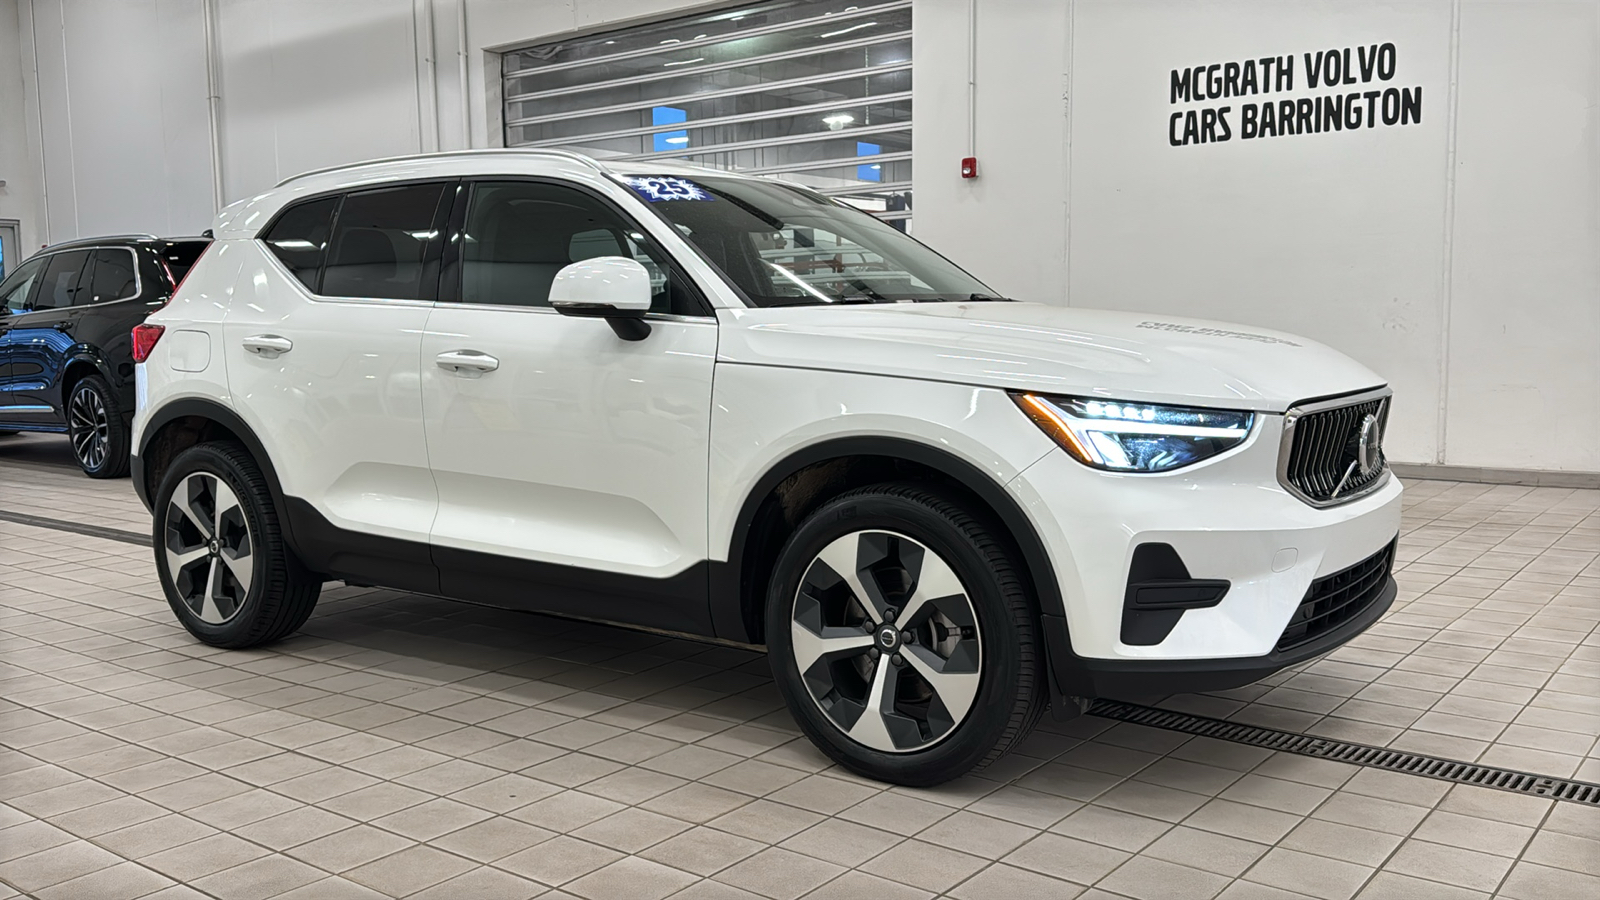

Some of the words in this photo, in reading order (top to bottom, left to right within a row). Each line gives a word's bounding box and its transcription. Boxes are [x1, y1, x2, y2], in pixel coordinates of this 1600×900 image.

[1170, 55, 1294, 105] MCGRATH
[1304, 42, 1396, 89] VOLVO
[1169, 106, 1231, 147] CARS
[1241, 86, 1422, 140] BARRINGTON
[648, 181, 690, 195] 25
